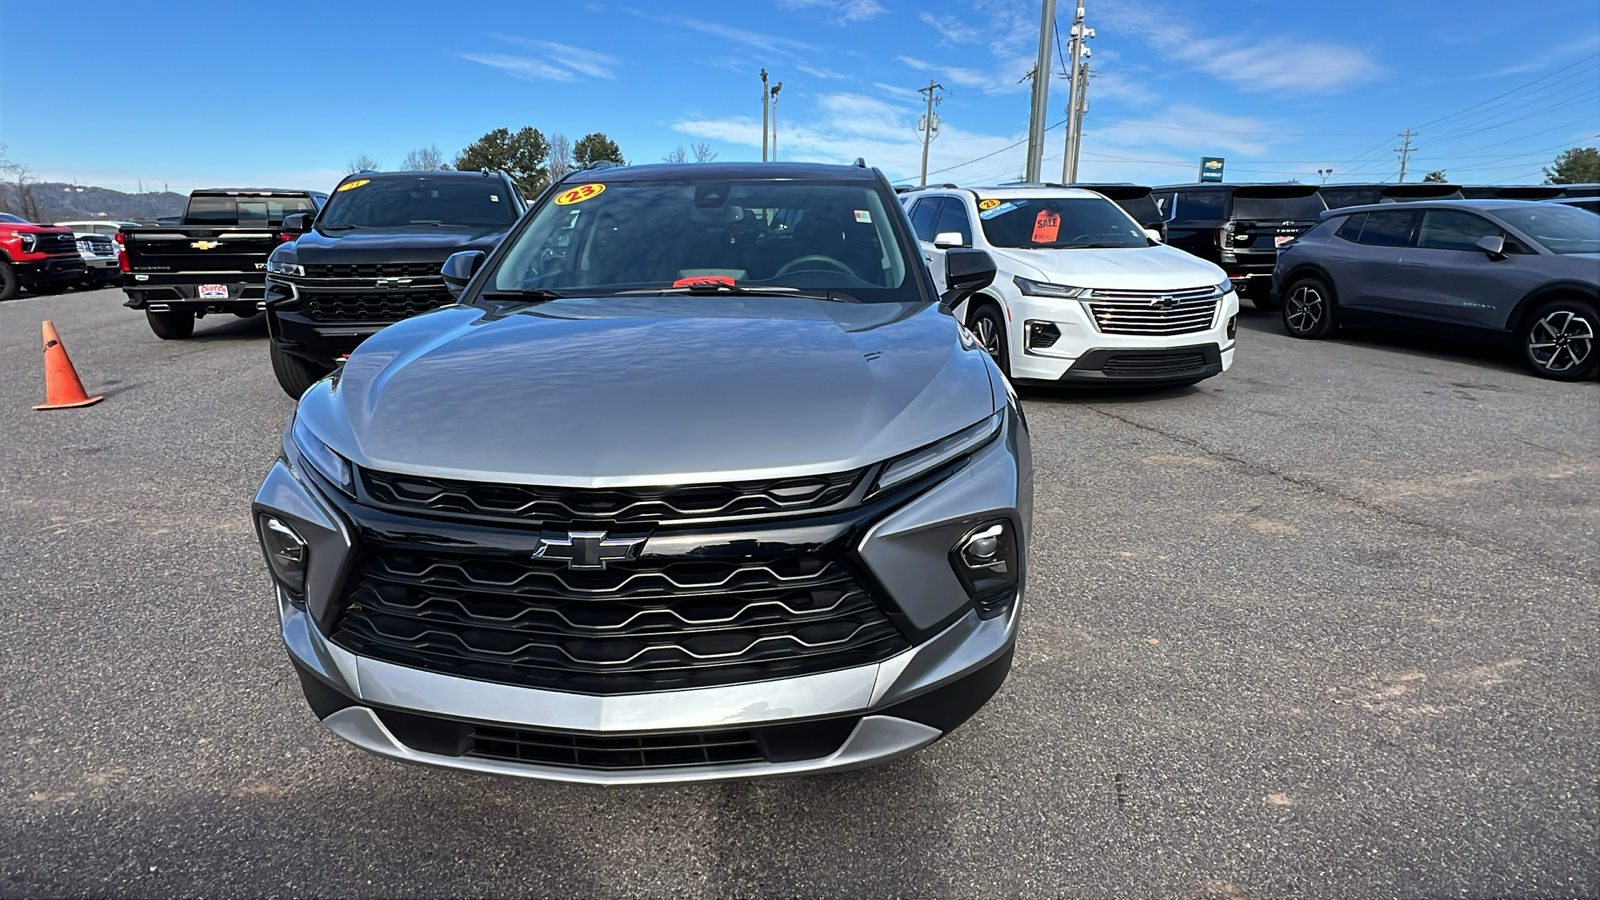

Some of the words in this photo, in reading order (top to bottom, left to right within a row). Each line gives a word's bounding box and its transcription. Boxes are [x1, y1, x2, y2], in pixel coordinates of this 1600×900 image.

[565, 186, 596, 203] 23
[983, 200, 996, 209] 23
[1037, 219, 1058, 229] SALE
